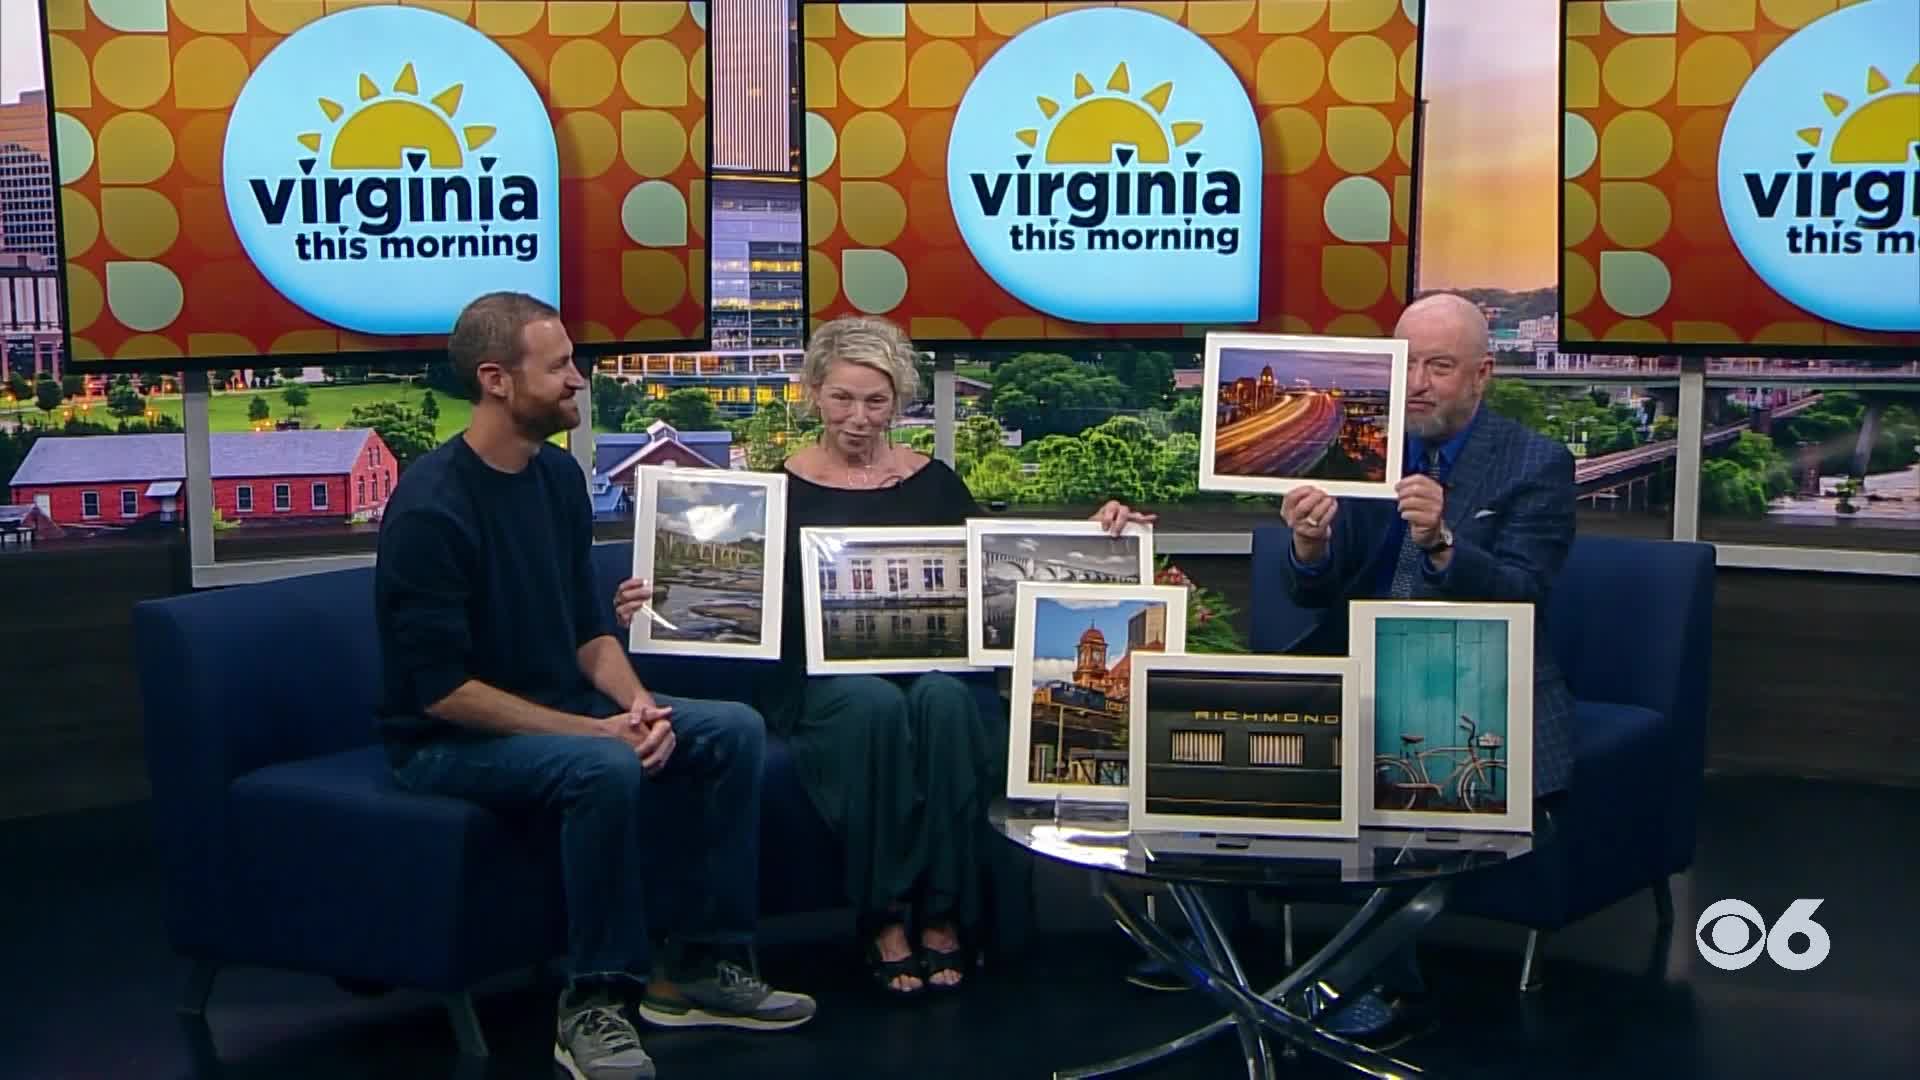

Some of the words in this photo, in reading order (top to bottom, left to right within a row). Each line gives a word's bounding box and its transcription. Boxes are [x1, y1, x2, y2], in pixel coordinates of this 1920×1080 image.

[249, 153, 539, 236] virginia
[970, 148, 1241, 228] virginia
[295, 226, 368, 261] this
[380, 225, 539, 262] morning
[1009, 218, 1076, 251] this
[1087, 218, 1239, 255] morning
[1786, 219, 1863, 254] this
[1876, 230, 1920, 254] m
[1194, 710, 1339, 724] RICHMOND
